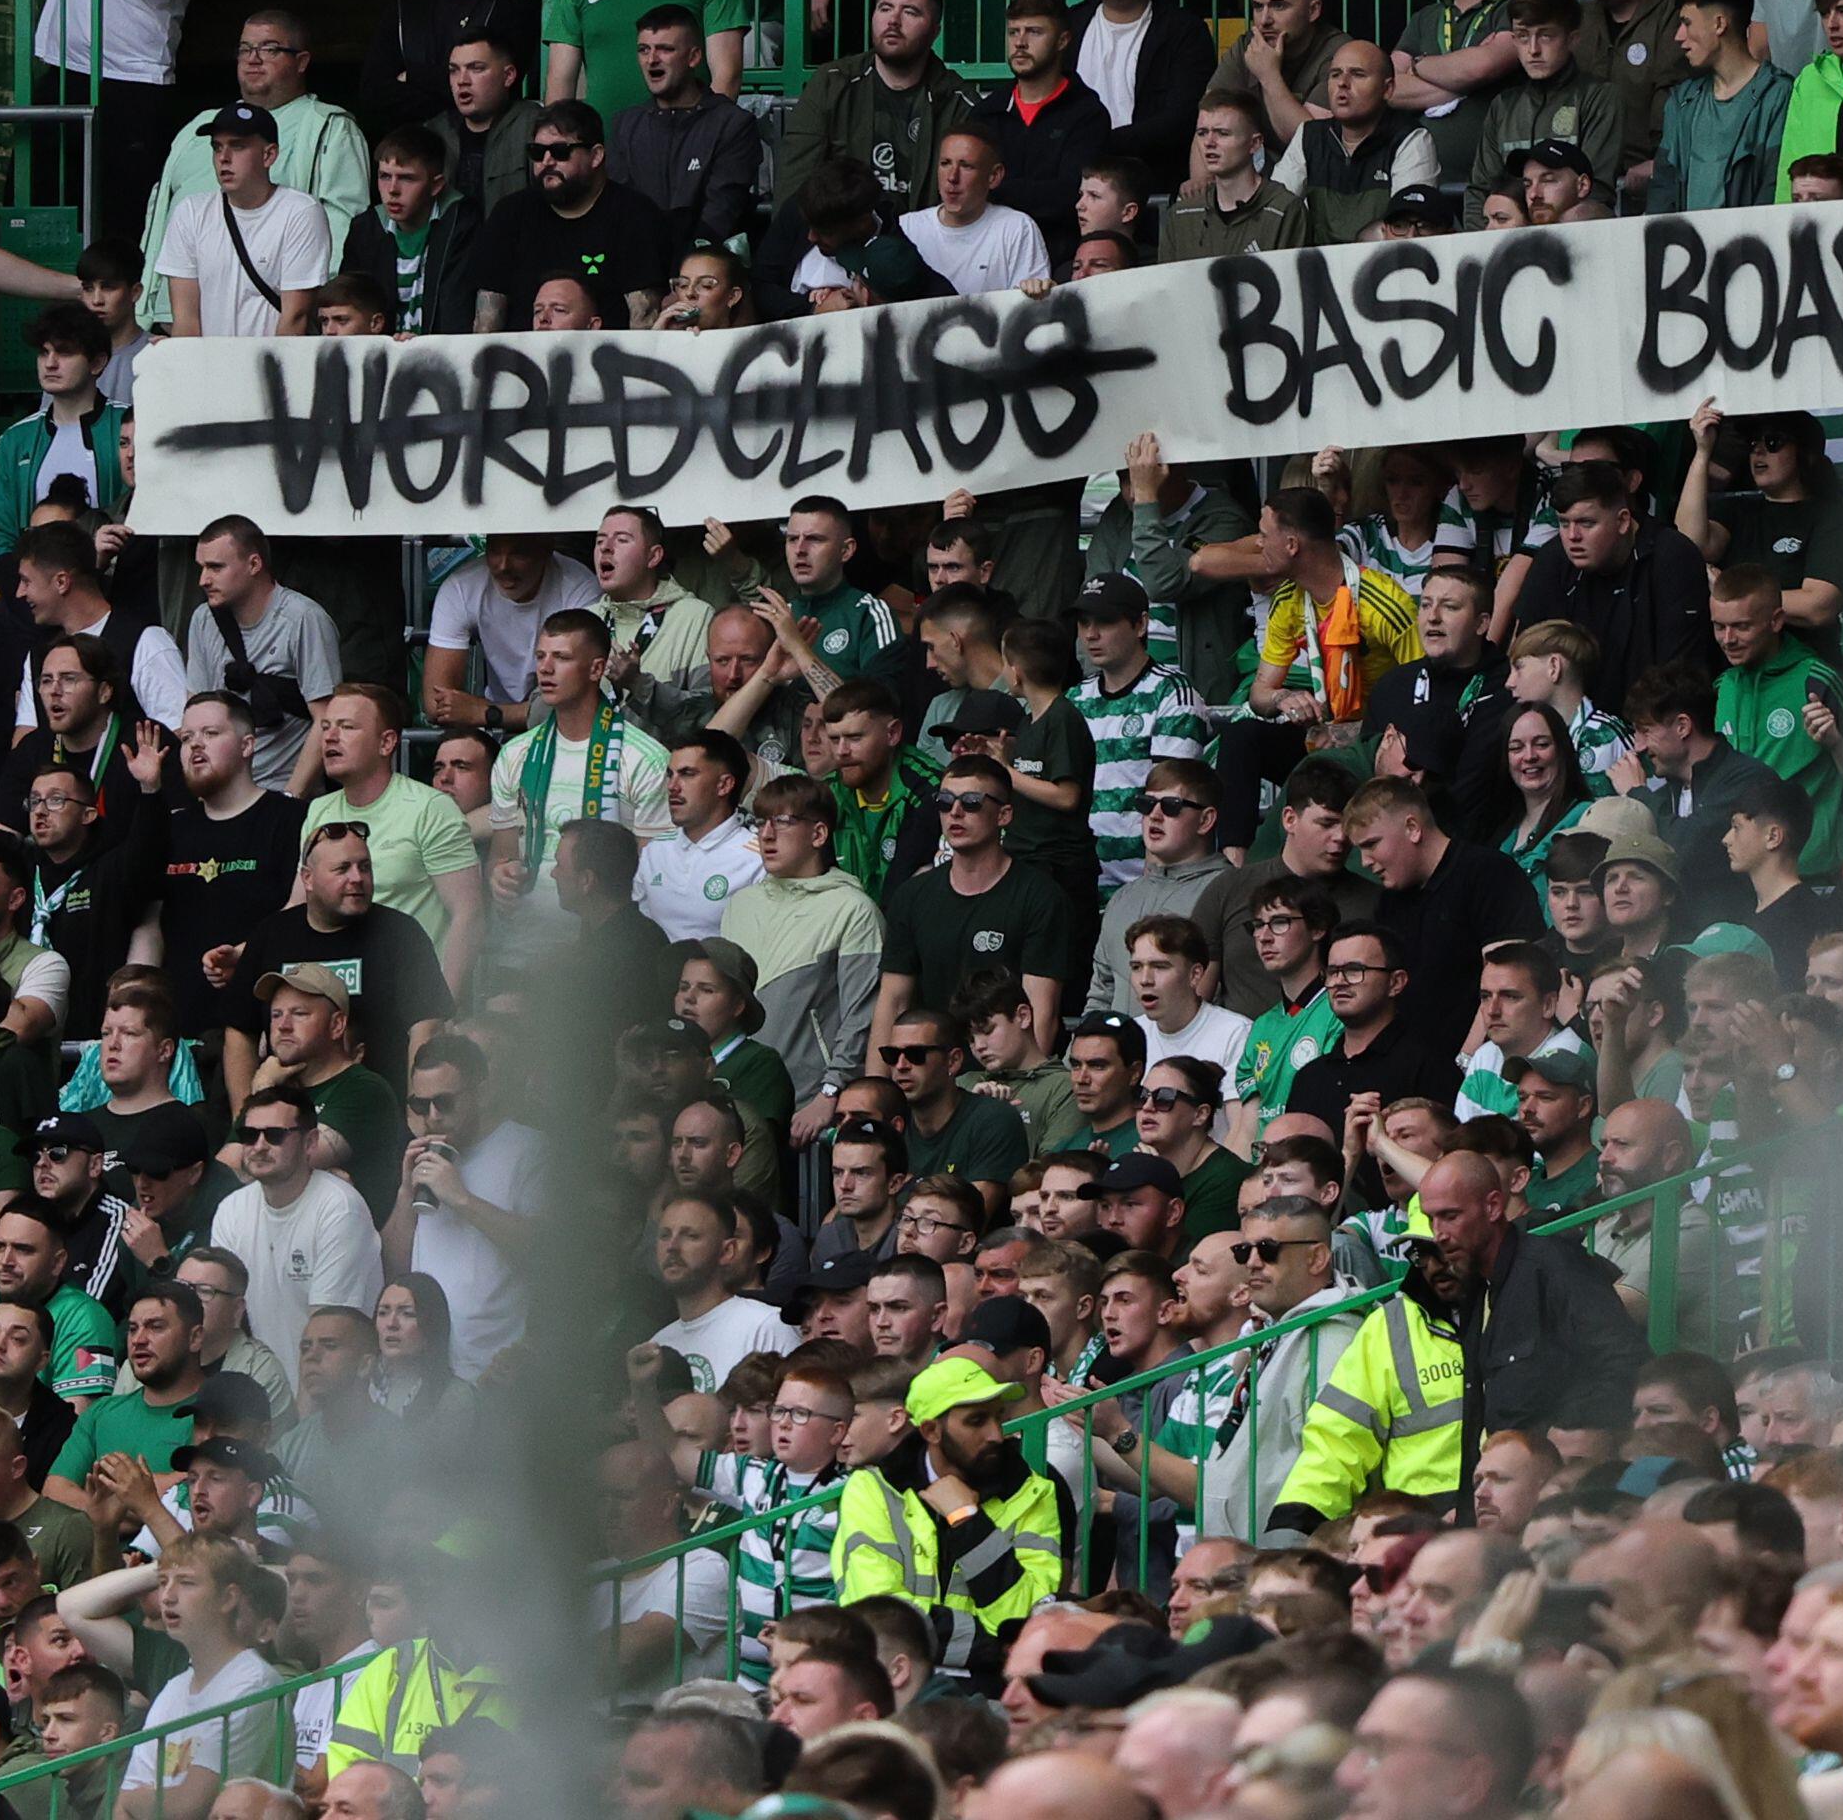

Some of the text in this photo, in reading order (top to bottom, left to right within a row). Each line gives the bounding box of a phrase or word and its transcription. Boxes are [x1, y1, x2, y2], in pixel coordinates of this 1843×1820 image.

[1208, 231, 1572, 425] BASIC
[599, 706, 613, 733] OF
[587, 743, 606, 789] OUR
[1419, 1360, 1464, 1386] 3008
